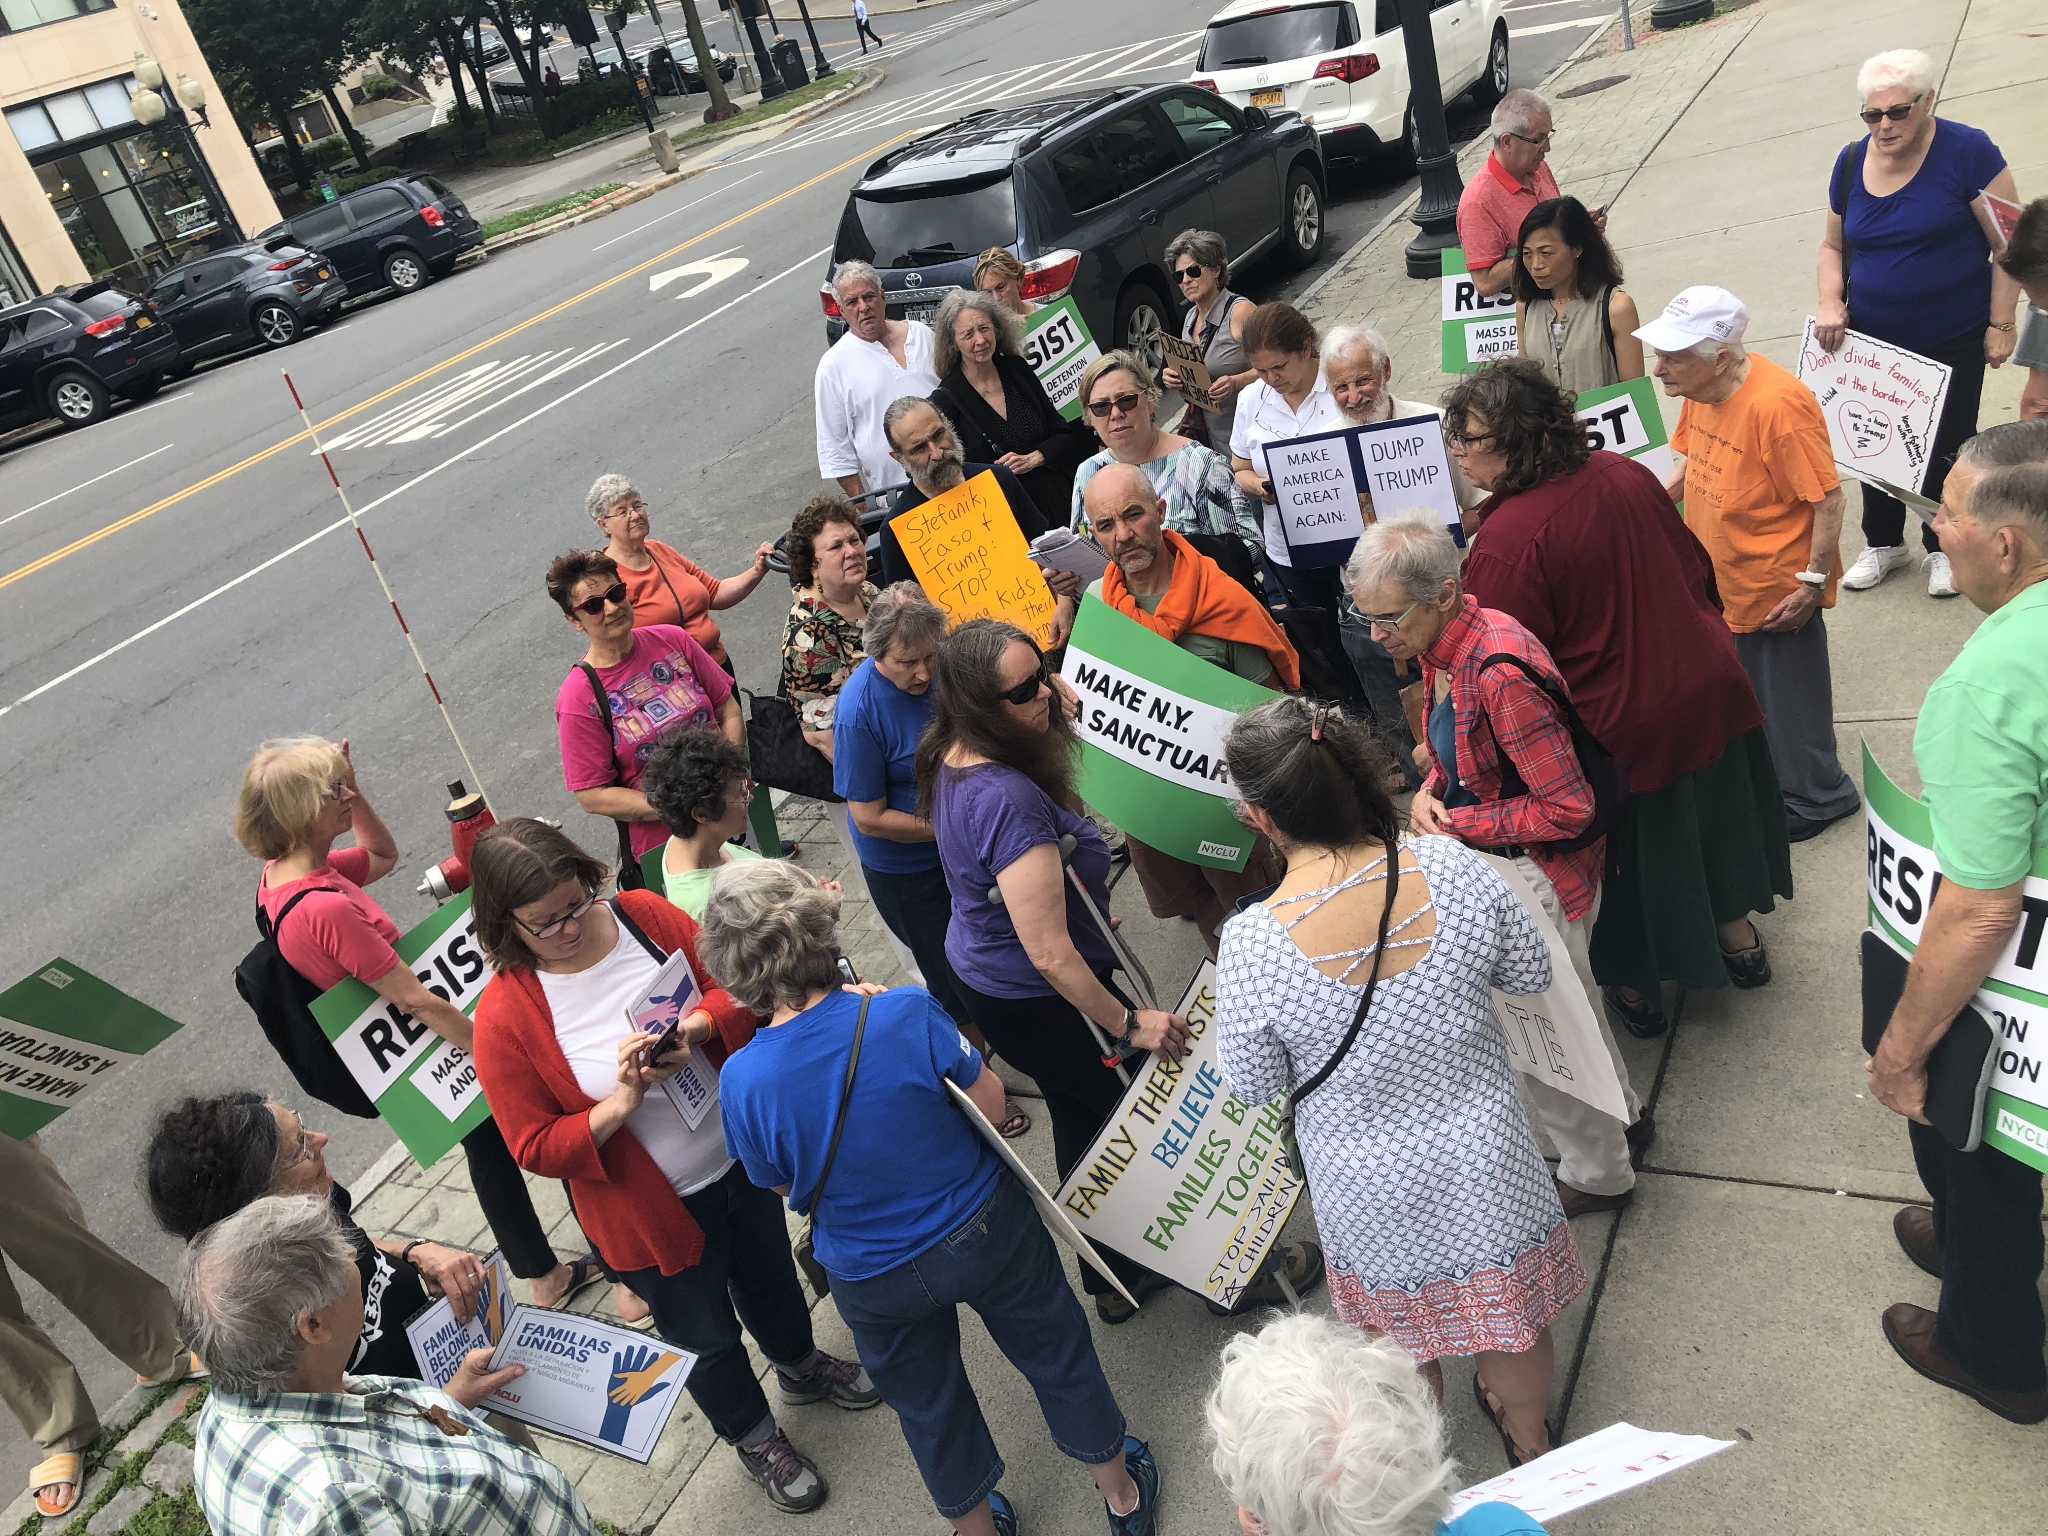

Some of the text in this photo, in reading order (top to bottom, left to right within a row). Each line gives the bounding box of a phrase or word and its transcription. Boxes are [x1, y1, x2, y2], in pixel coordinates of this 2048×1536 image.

[1476, 325, 1506, 340] MASS
[1477, 340, 1519, 354] AND DE
[1046, 356, 1088, 392] DETENTION
[1843, 345, 1881, 370] divide
[1888, 362, 1931, 405] families
[1821, 386, 1838, 407] child
[1852, 376, 1867, 393] the
[1872, 381, 1915, 412] border!
[1370, 436, 1424, 463] DUMP
[1863, 424, 1886, 440] Trump
[1287, 448, 1330, 467] MAKE
[1283, 467, 1344, 487] AMERICA
[1374, 465, 1439, 492] TRUMP
[1293, 487, 1341, 506] GREAT
[906, 485, 988, 544] Stefanik,
[1296, 510, 1347, 529] AGAIN:
[919, 529, 972, 565] Faso
[938, 567, 992, 614] STOP
[1074, 662, 1195, 734] MAKE N.Y.
[1201, 843, 1238, 858] NYCLU
[1867, 817, 2048, 971] REST
[359, 922, 484, 1075] RESIS
[16, 1072, 87, 1098] MAKE
[91, 1060, 118, 1075] A
[450, 1064, 477, 1101] AND
[1066, 985, 1216, 1220] FAMILY THERISTS
[1150, 1060, 1223, 1170] BELIEVE
[2001, 1114, 2048, 1148] NYCL
[1143, 1129, 1232, 1251] FAMILIES
[1239, 1177, 1298, 1273] CHILDREN
[1208, 1225, 1246, 1290] STOP
[429, 1328, 470, 1373] BELONG
[516, 1334, 591, 1364] UNIDAS
[522, 1322, 612, 1354] FAMILIAS
